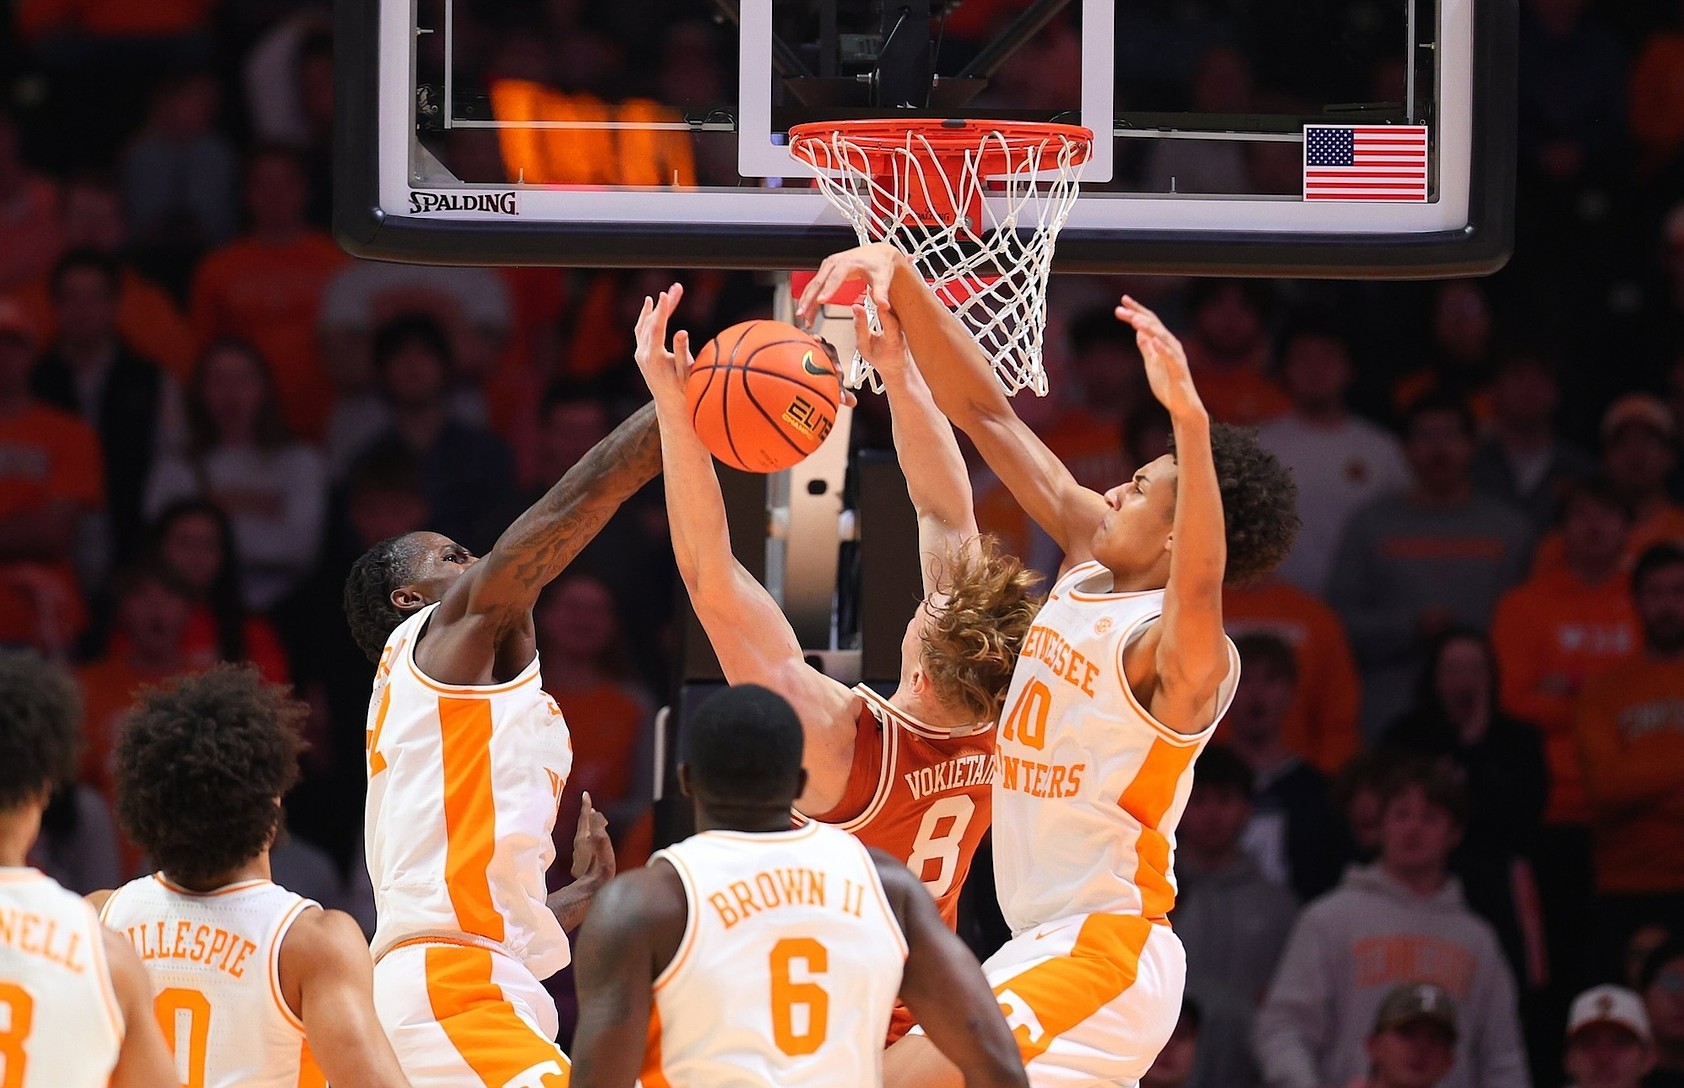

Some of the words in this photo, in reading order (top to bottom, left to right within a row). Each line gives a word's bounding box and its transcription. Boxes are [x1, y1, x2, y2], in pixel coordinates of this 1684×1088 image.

[409, 191, 516, 216] SPALDING
[1002, 675, 1052, 751] 10
[906, 794, 976, 898] 8
[708, 868, 826, 930] BROWN
[842, 879, 865, 918] II
[120, 921, 257, 979] ILLESPIE
[768, 936, 829, 1058] 6
[153, 987, 211, 1088] 0
